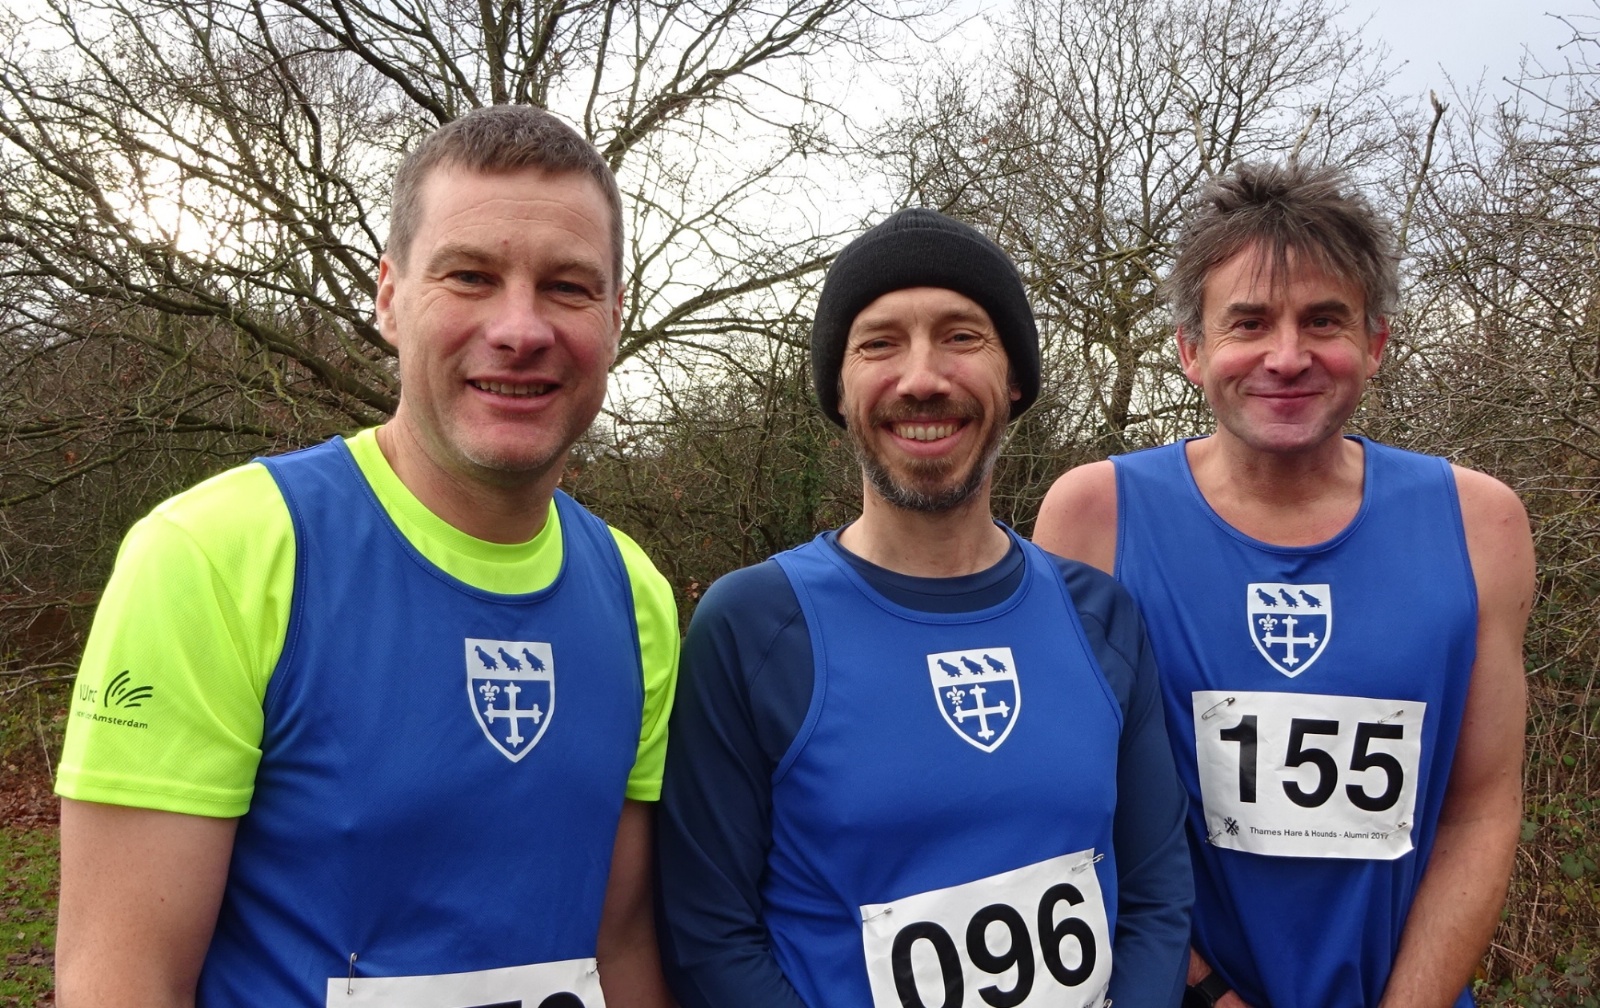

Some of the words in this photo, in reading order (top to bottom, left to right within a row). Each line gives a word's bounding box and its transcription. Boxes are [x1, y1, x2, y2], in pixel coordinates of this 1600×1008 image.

[92, 714, 148, 729] Amsterdam
[1220, 715, 1404, 812] 155
[1250, 826, 1282, 836] Thames
[1284, 828, 1303, 837] Hare
[1304, 829, 1310, 838] &
[1311, 829, 1338, 838] Hounds
[1343, 830, 1369, 840] Alumni
[892, 882, 1096, 1008] 096
